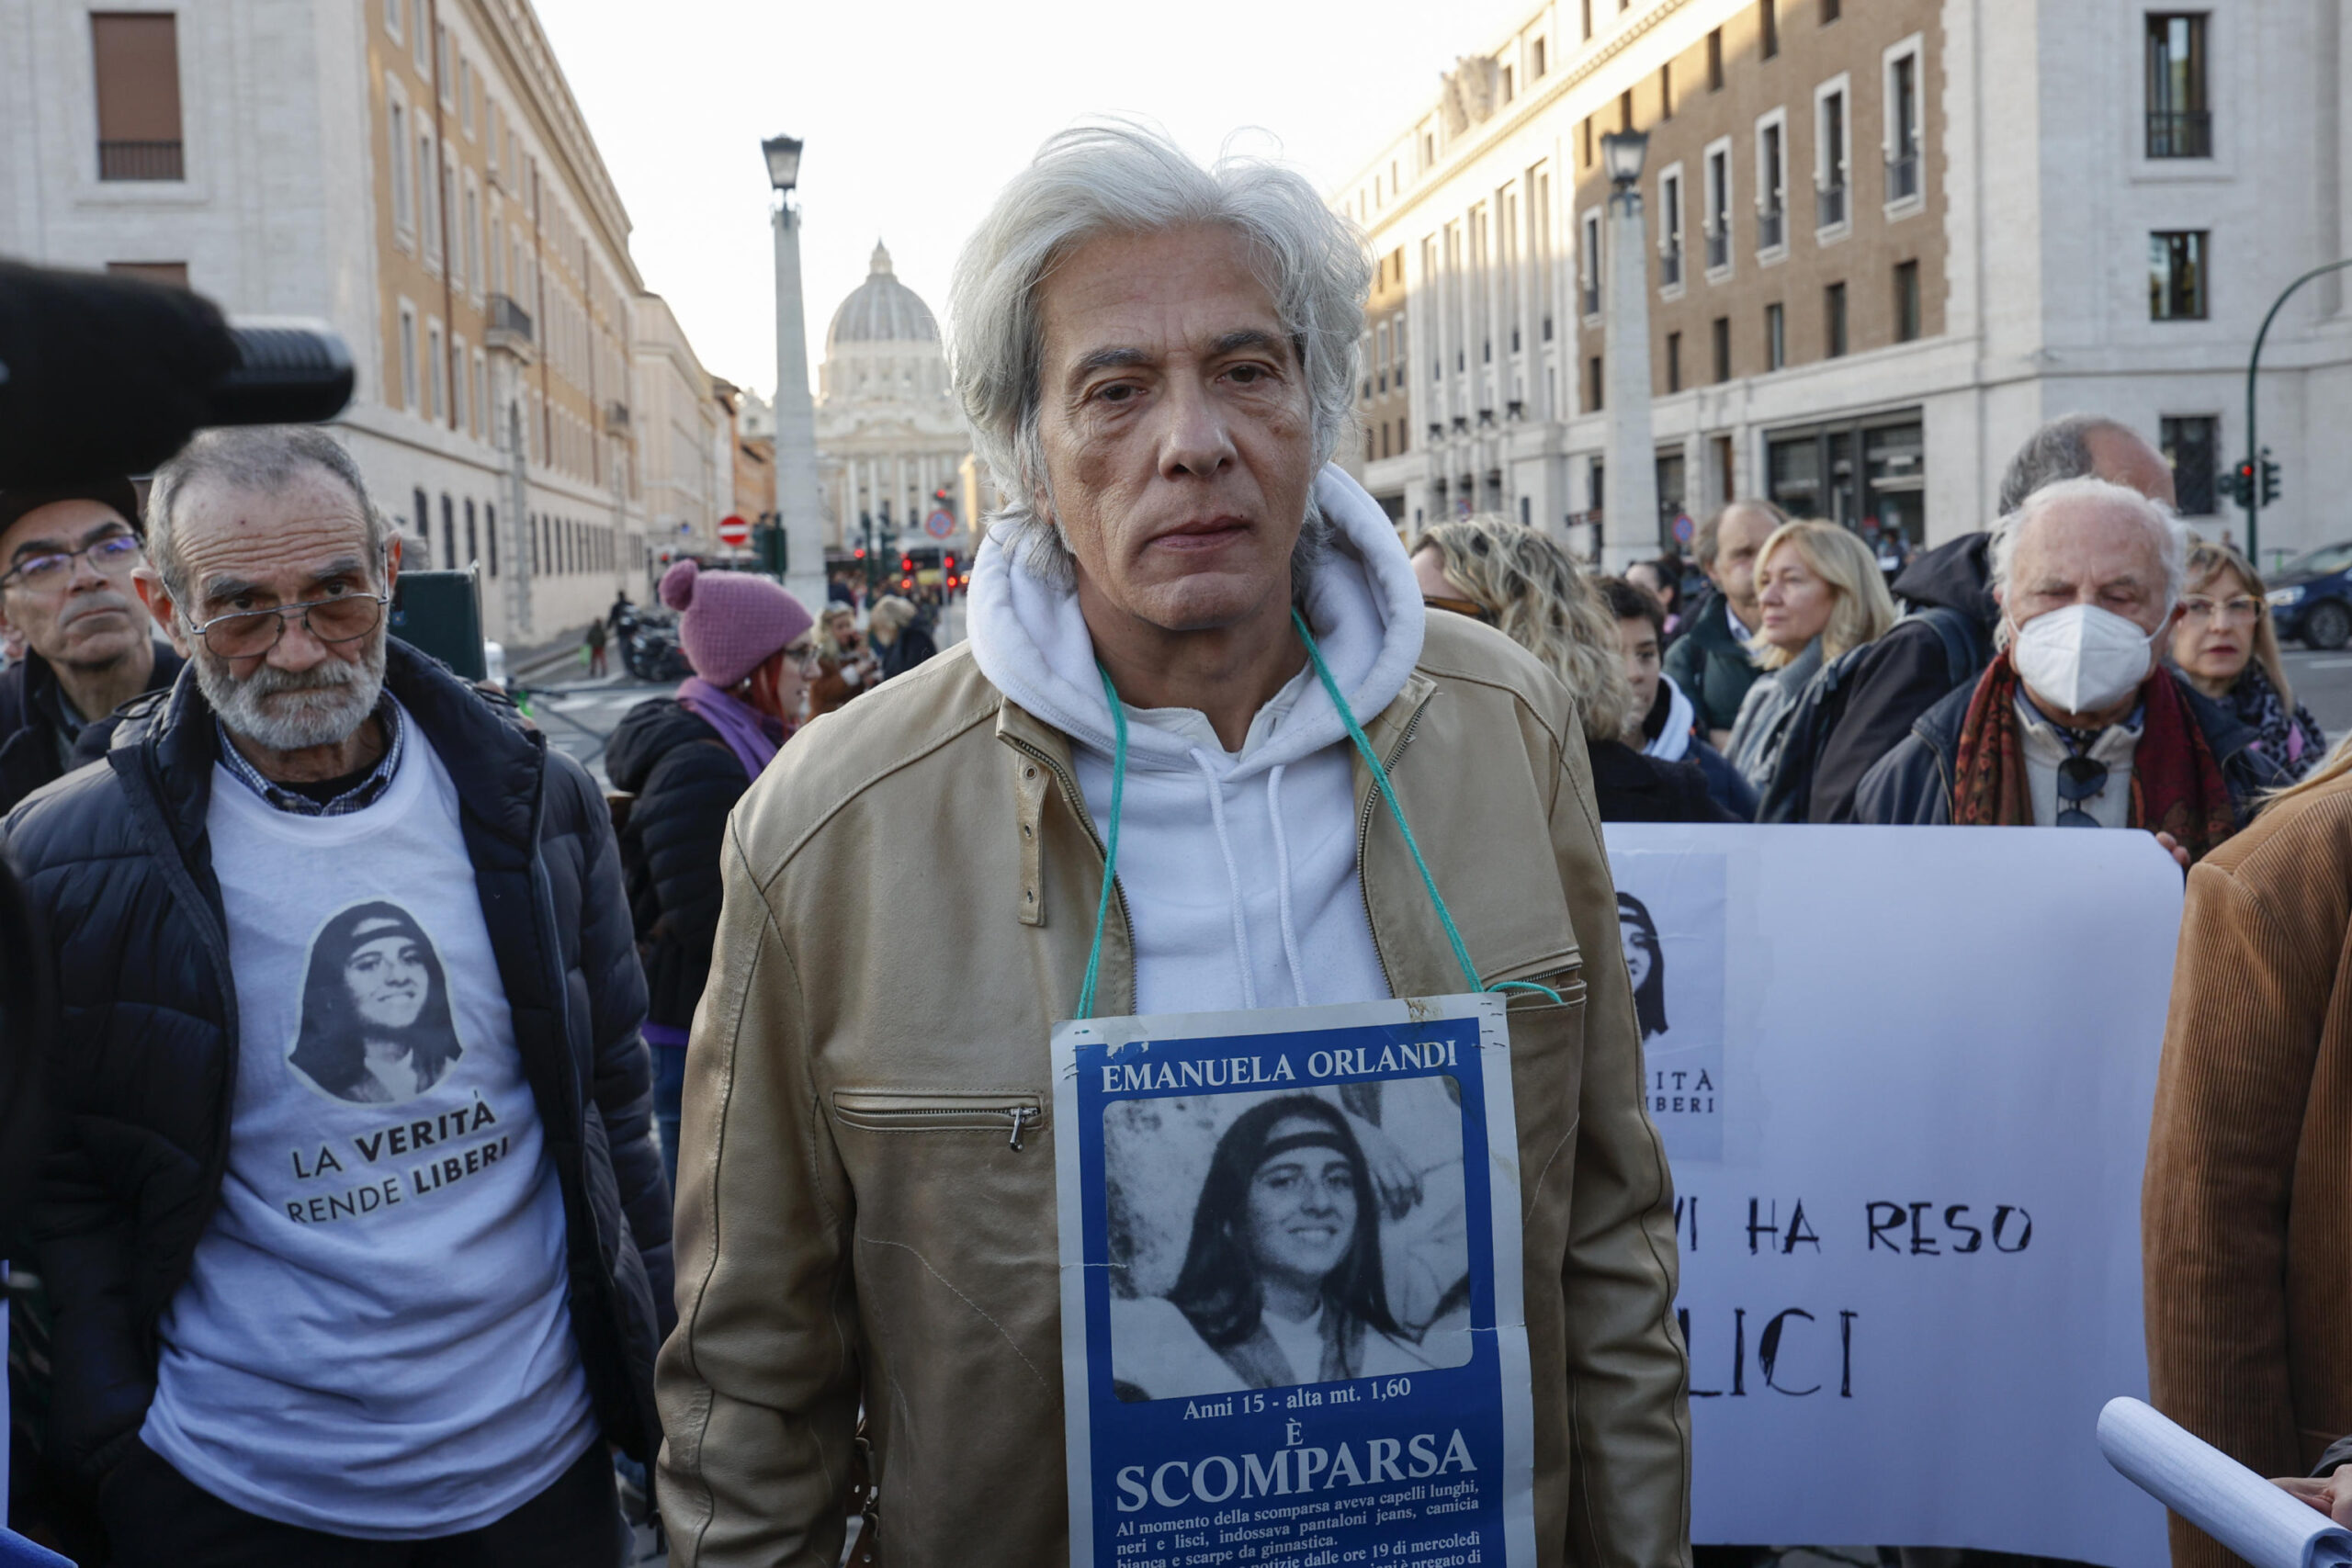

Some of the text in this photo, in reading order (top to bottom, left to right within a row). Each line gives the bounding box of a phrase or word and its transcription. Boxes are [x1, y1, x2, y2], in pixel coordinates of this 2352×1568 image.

[1101, 1039, 1458, 1093] EMANUELA ORLANDI
[1645, 1067, 1714, 1092] ITÀ
[292, 1089, 497, 1179] LA VERITÀ
[287, 1135, 510, 1224] RENDE LIBERI
[1746, 1197, 1821, 1256] HA
[1865, 1200, 2032, 1257] RESO
[1183, 1396, 1234, 1421] Anni
[1242, 1393, 1265, 1415] 15
[1286, 1387, 1323, 1409] alta
[1329, 1384, 1362, 1404] mt.
[1371, 1377, 1412, 1403] 1,60
[1285, 1416, 1304, 1447] È
[1115, 1427, 1478, 1513] SCOMPARSA
[1115, 1479, 1480, 1538] Al momento della scomparsa aveva capelli lunghi,
[1116, 1496, 1480, 1556] neri e lisci, indossava pantaloni jeans, camicia
[1116, 1534, 1339, 1568] bianca e scarpe da ginnastica.
[1304, 1551, 1340, 1568] dalle
[1342, 1549, 1367, 1562] ore
[1373, 1543, 1389, 1559] 19
[1392, 1540, 1408, 1556] di
[1410, 1530, 1481, 1553] mercoledì
[1467, 1549, 1482, 1564] di
